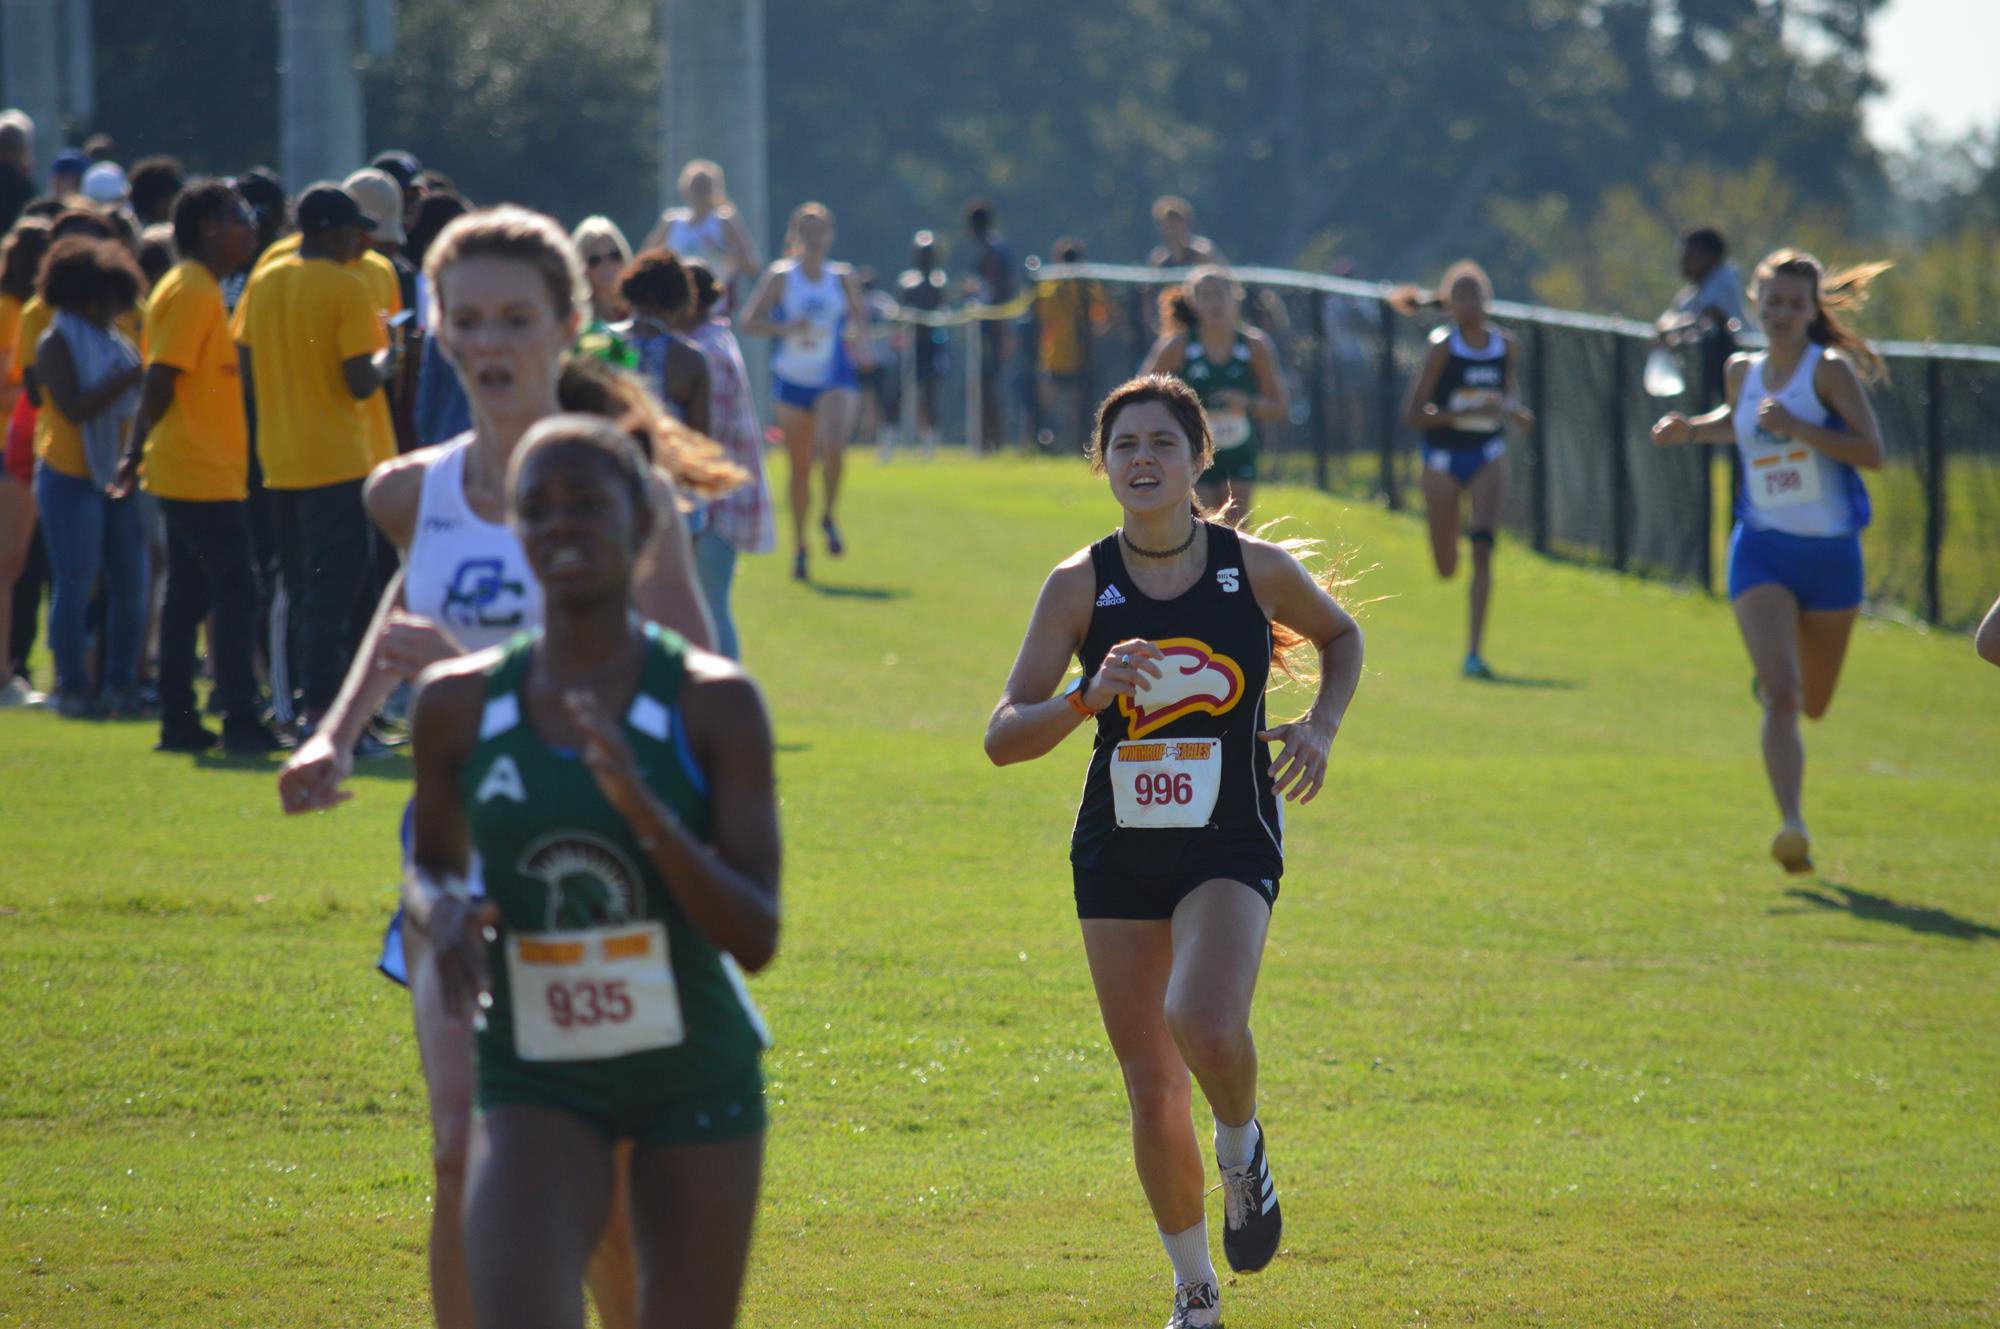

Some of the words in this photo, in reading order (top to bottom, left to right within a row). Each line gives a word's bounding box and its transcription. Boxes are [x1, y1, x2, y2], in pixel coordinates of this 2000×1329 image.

[1096, 596, 1126, 607] adidas
[1118, 743, 1167, 763] WINTHROP
[1134, 772, 1193, 806] 996
[546, 980, 634, 1029] 935
